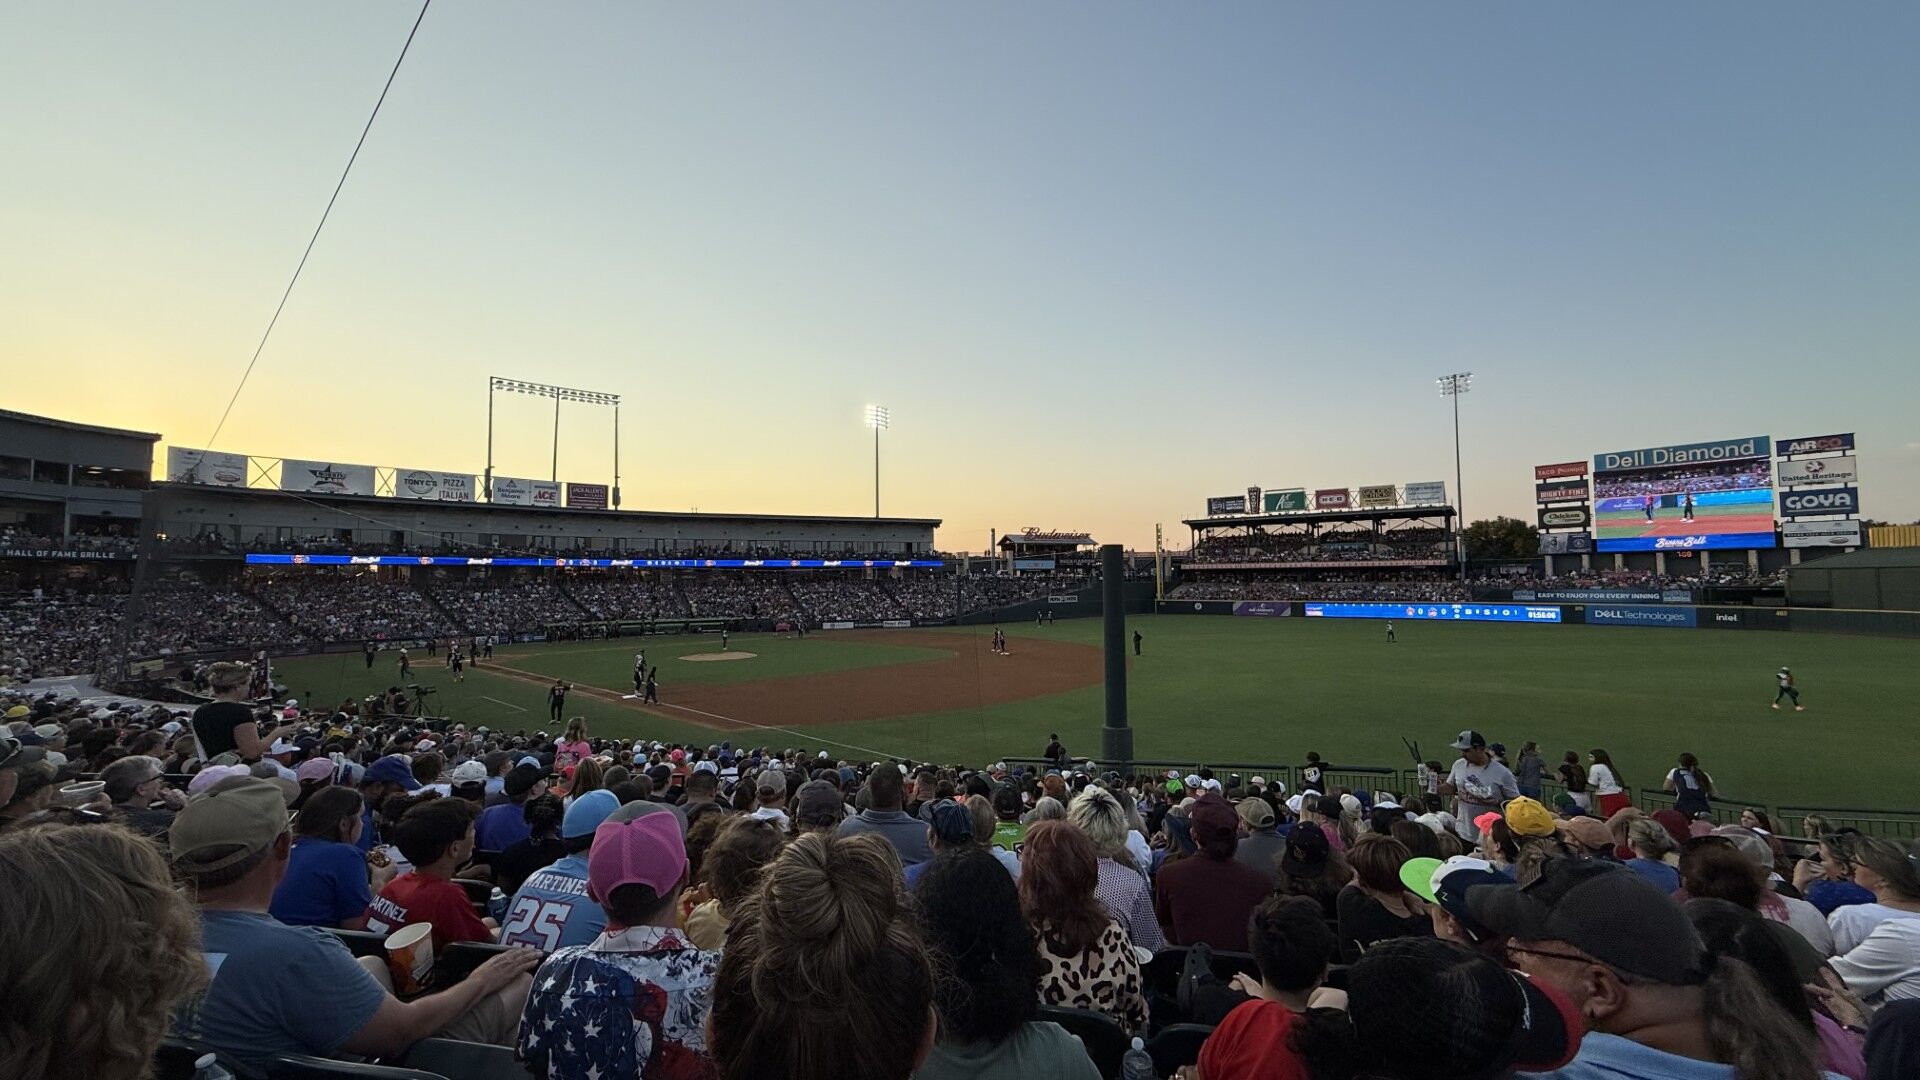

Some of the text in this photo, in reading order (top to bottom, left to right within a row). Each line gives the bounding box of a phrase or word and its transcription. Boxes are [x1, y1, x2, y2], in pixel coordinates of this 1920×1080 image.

[1605, 439, 1755, 469] Dell Diamond
[1812, 472, 1852, 480] Heritage
[403, 478, 425, 487] TONY
[442, 478, 466, 488] PIZZA
[439, 490, 469, 500] ITALIAN
[497, 486, 526, 496] Benjamin
[501, 492, 521, 500] Moore
[534, 490, 556, 500] ACE
[1568, 488, 1585, 496] FINE
[1785, 492, 1852, 510] GOYA
[1021, 526, 1091, 541] Budweiser
[1683, 536, 1706, 547] Ball
[6, 549, 33, 557] HALL
[51, 550, 78, 558] FAME
[79, 551, 116, 559] GRILLE
[1606, 592, 1629, 600] EVERY
[1630, 592, 1660, 600] INNING
[1594, 609, 1685, 622] DELL Technologies
[500, 897, 572, 953] 25
